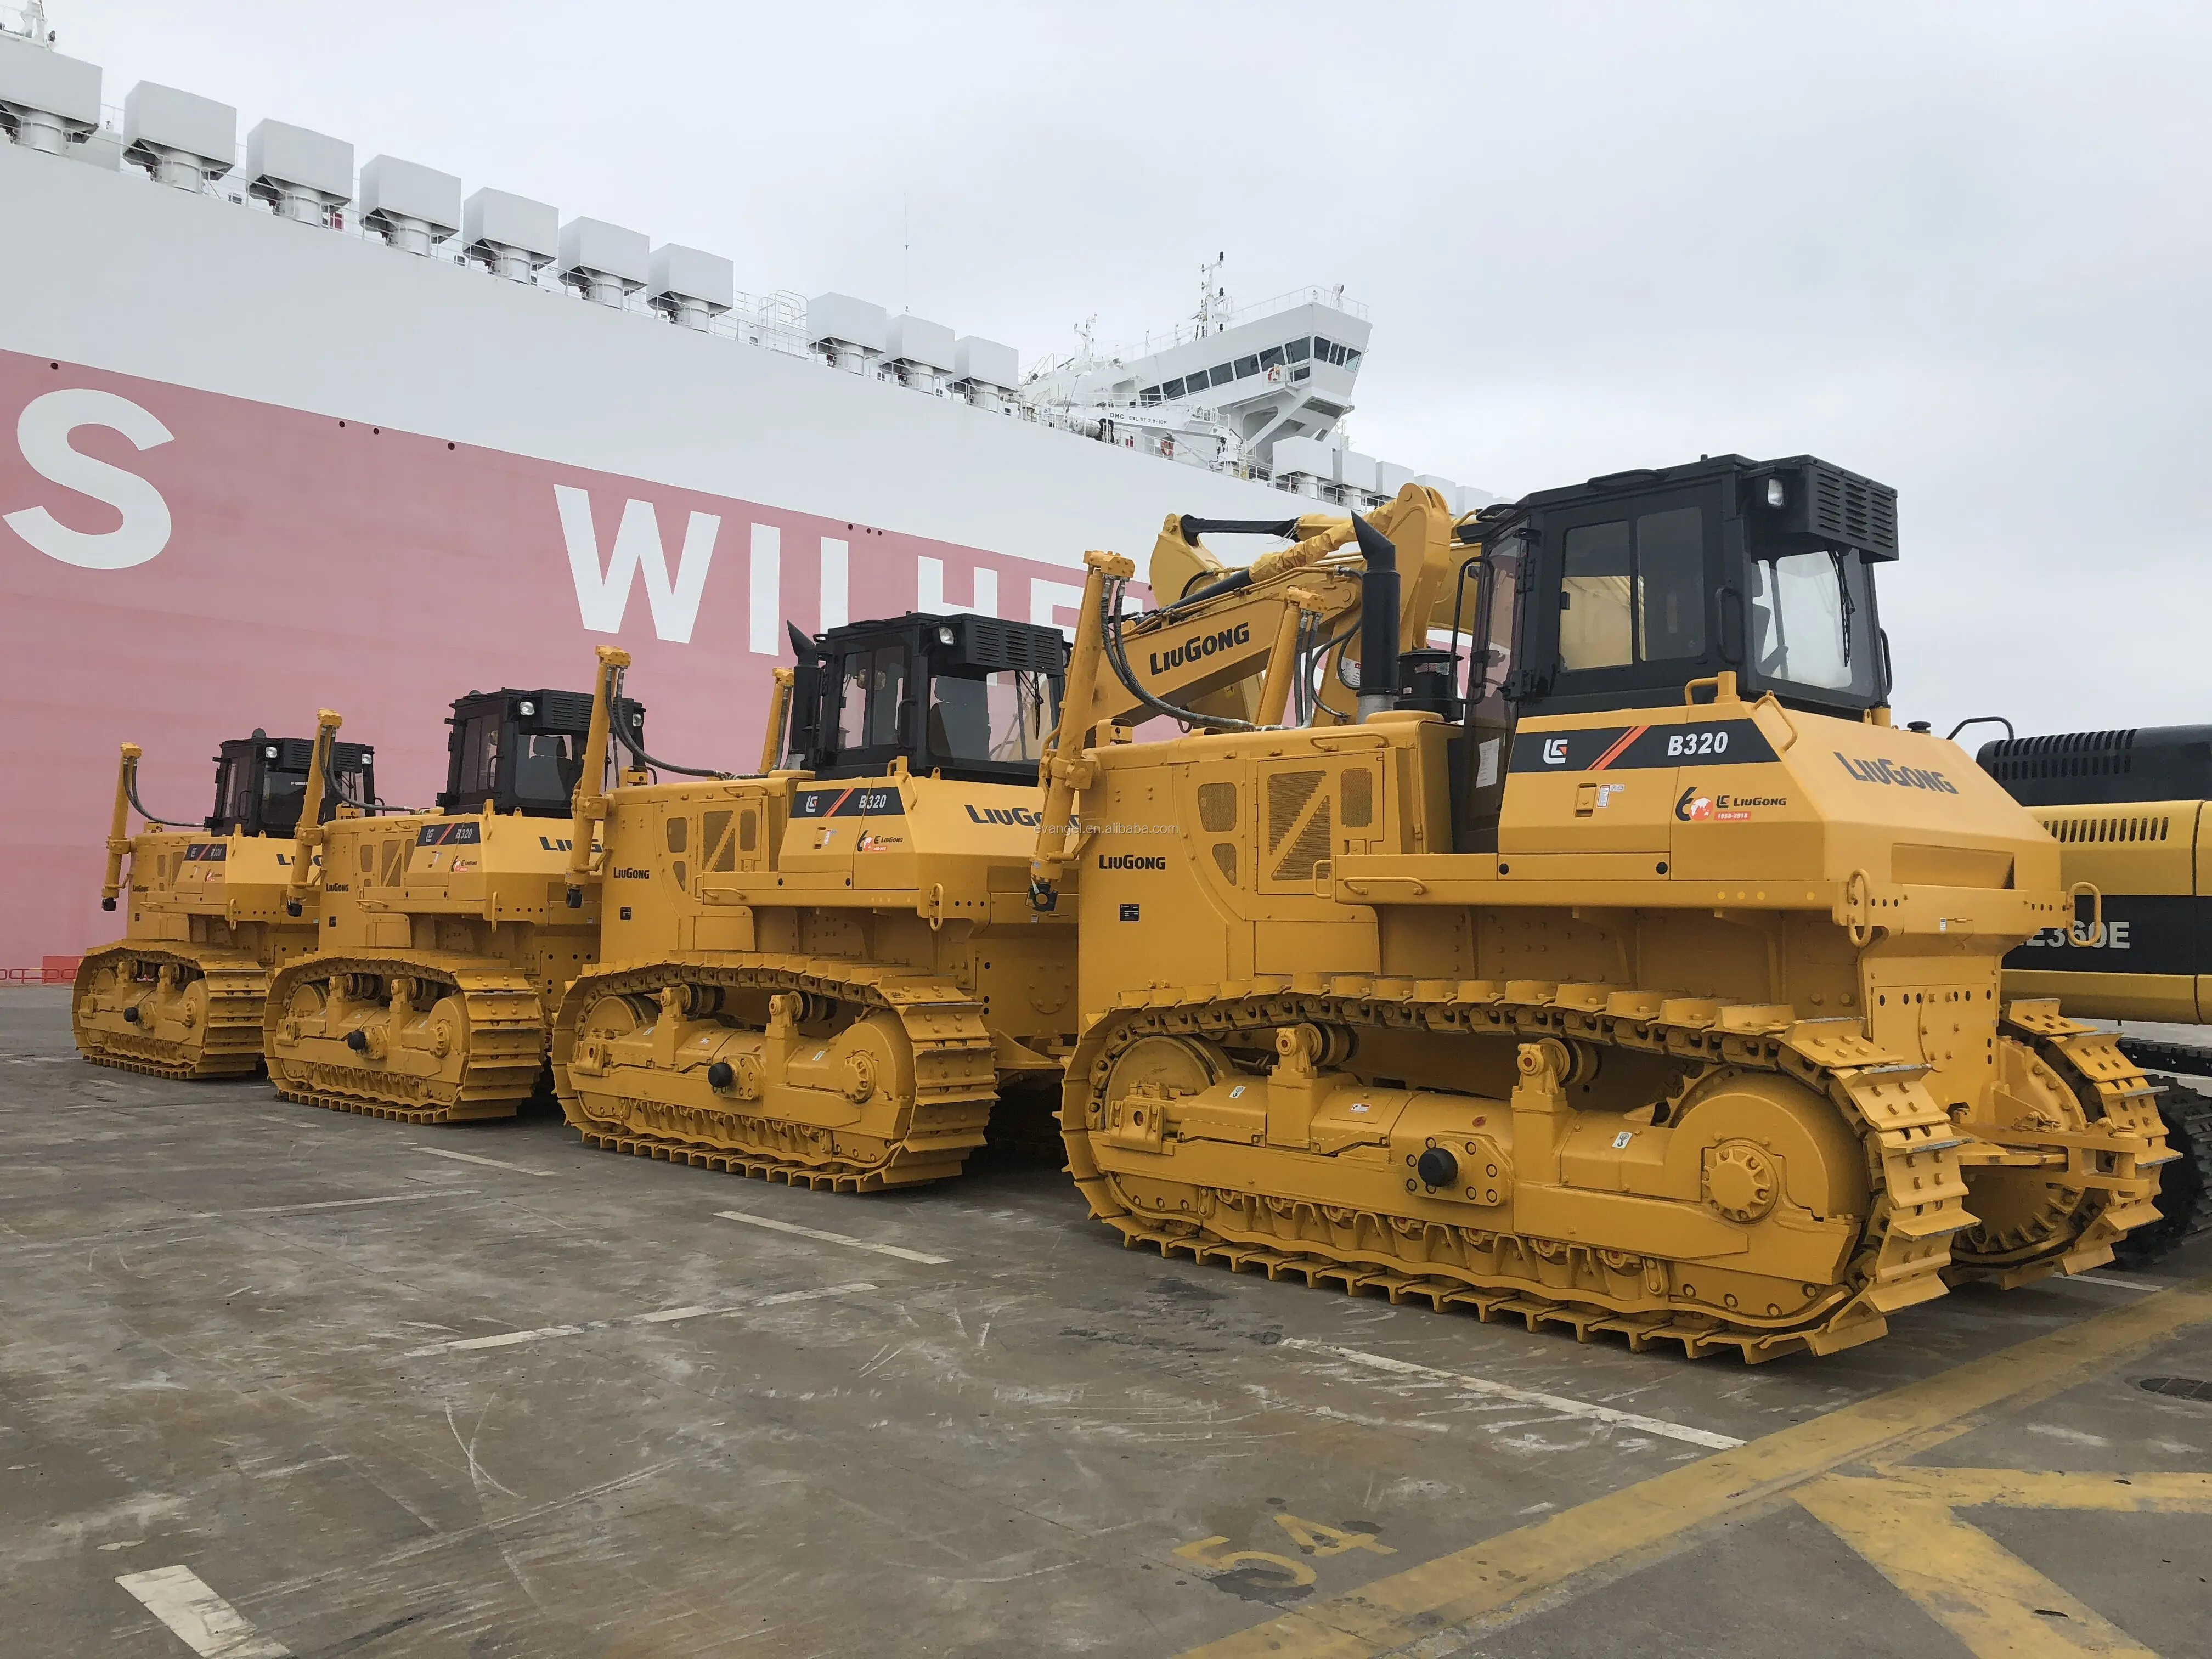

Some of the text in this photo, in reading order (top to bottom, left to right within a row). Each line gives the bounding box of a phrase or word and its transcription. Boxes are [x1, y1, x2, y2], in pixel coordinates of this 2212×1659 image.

[2, 388, 175, 569] S
[1667, 731, 1729, 757] B320
[858, 794, 887, 809] B320
[455, 828, 473, 839] B320
